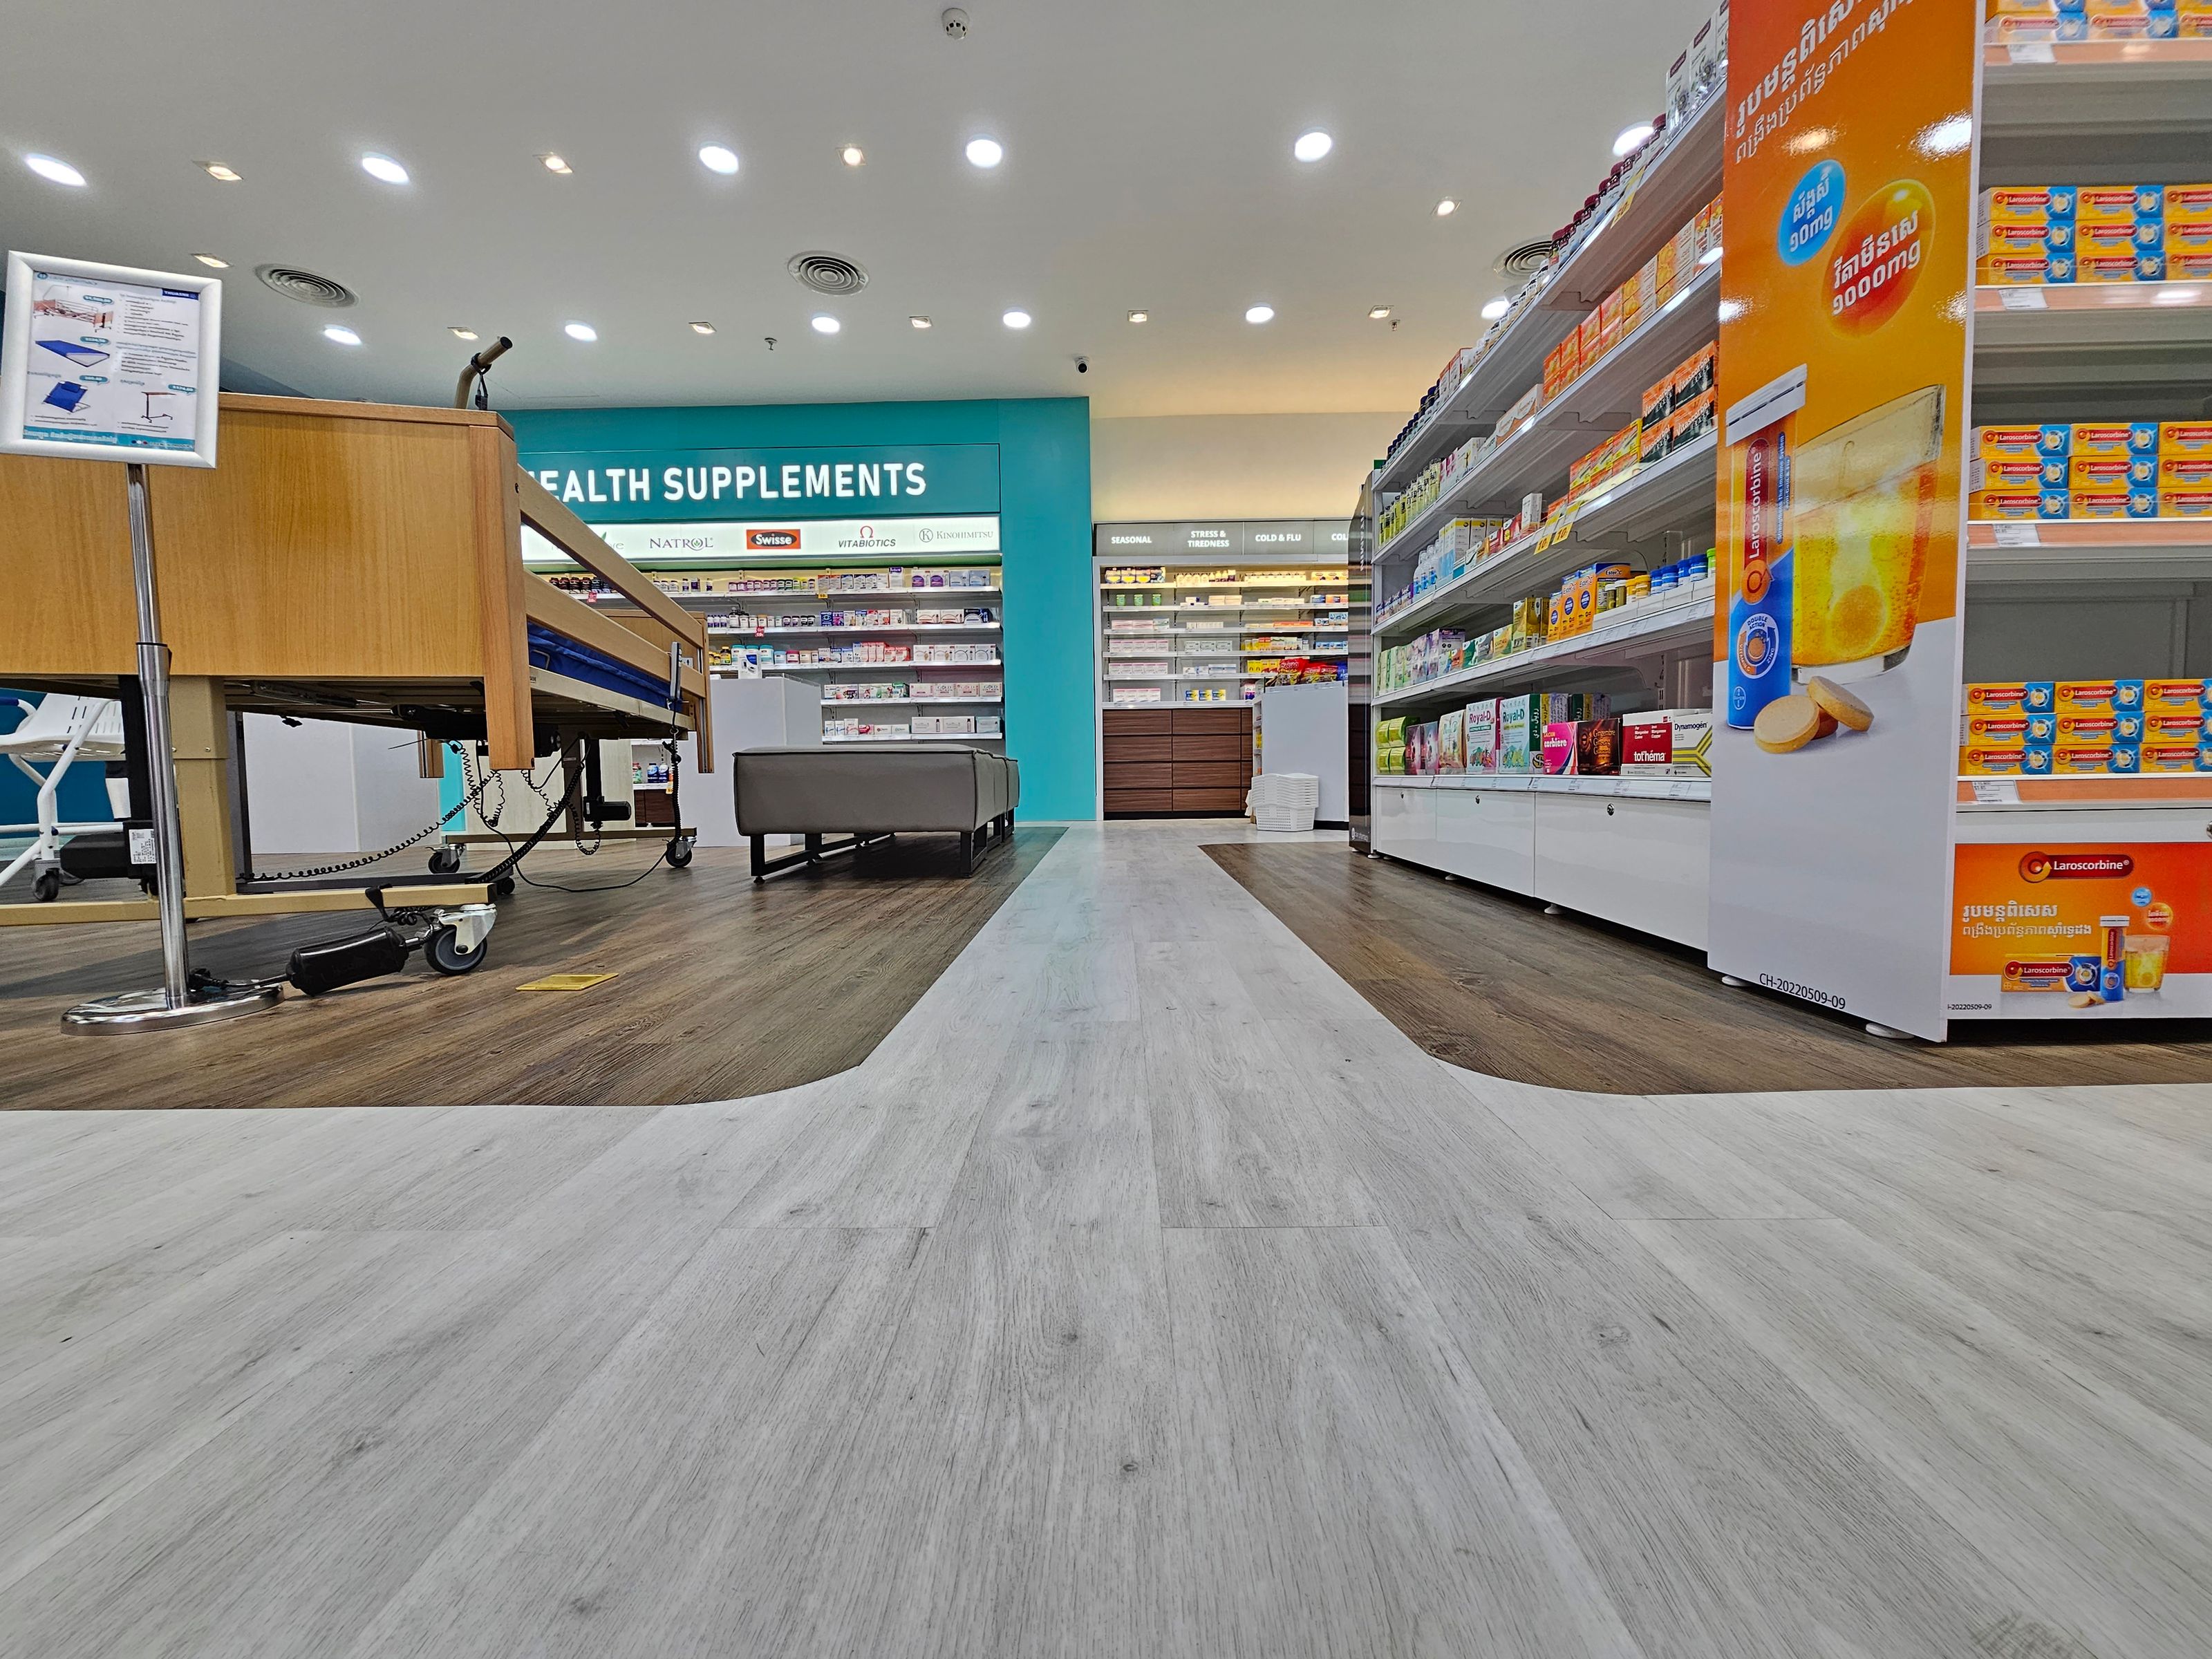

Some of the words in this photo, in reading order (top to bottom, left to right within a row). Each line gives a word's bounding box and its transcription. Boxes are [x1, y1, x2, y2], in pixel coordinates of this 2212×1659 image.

[528, 468, 650, 503] EALTH
[664, 462, 926, 500] SUPPLEMENTS
[756, 534, 792, 545] Swisse
[936, 530, 993, 539] KINOHIMITSU
[1112, 536, 1152, 544] SEASONAL
[838, 538, 897, 548] VITABIOTICS
[1747, 615, 1768, 626] DOUBLE
[1750, 621, 1766, 630] ACTION
[1469, 711, 1491, 724] Royal-D
[1503, 709, 1525, 723] Royal-D
[1759, 973, 1846, 1009] CH-20220509-09
